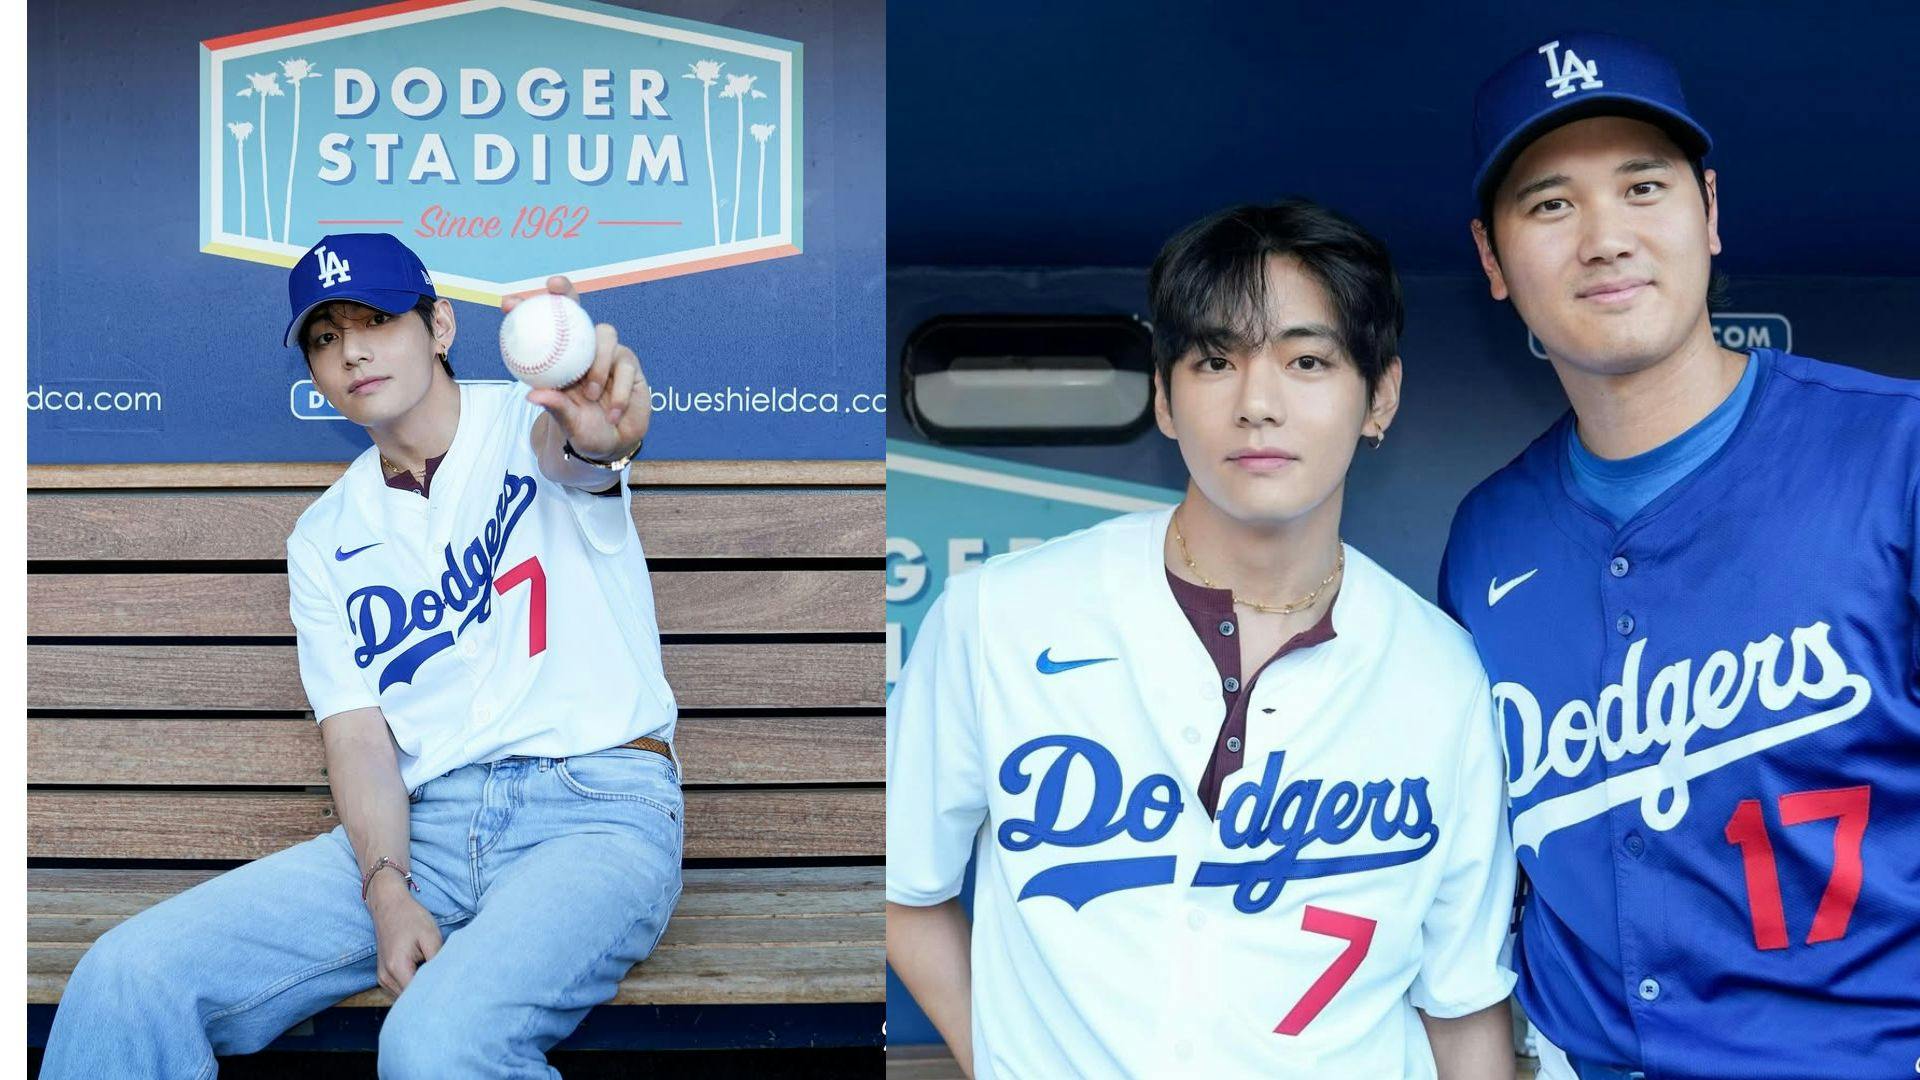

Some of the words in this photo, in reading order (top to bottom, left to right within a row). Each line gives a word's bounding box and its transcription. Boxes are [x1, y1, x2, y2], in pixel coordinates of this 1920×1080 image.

[333, 67, 672, 120] DODGER
[1538, 40, 1603, 99] LA
[317, 132, 688, 186] STADIUM
[414, 204, 503, 239] Since
[510, 205, 591, 239] 1962
[314, 245, 352, 289] LA
[27, 384, 162, 411] dca.com
[347, 469, 537, 690] Dodgers
[493, 555, 547, 658] 7
[1491, 621, 1872, 858] Dodgers
[998, 734, 1440, 914] Dodgers
[1725, 785, 1871, 951] 17
[1273, 904, 1378, 1037] 7
